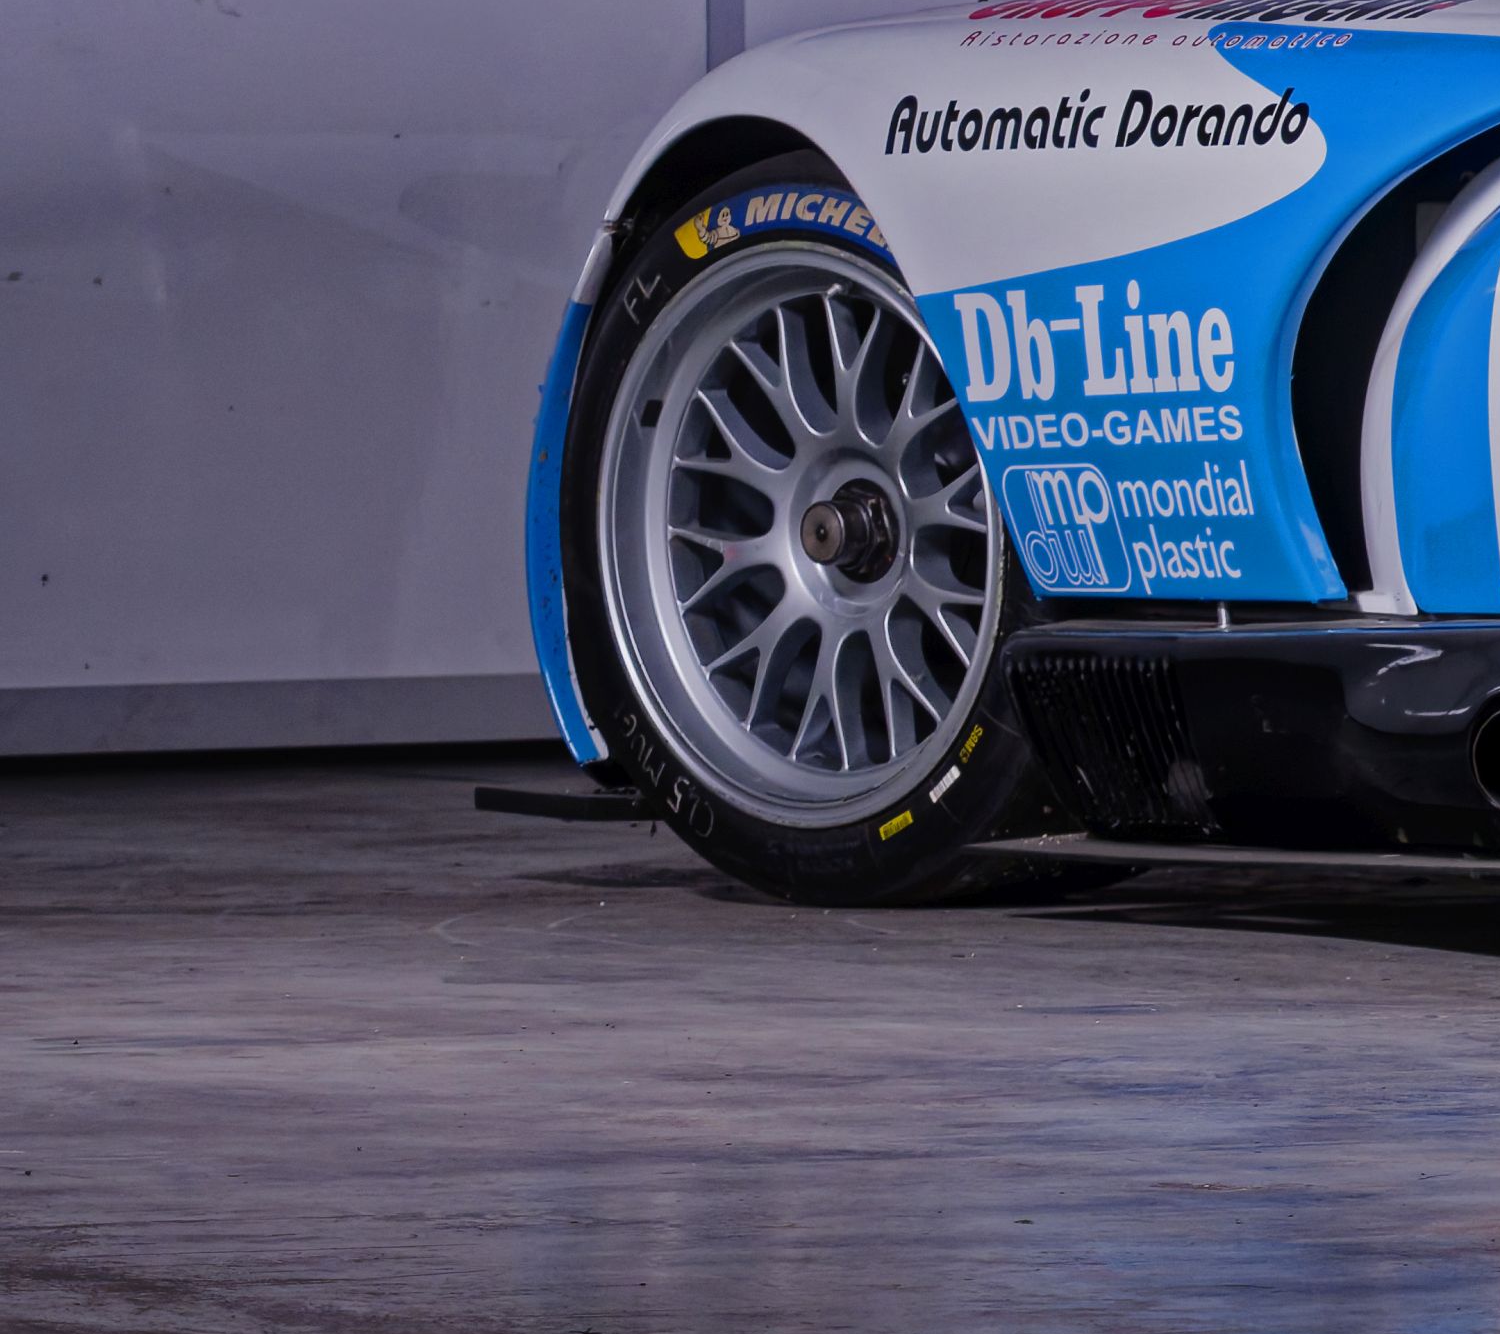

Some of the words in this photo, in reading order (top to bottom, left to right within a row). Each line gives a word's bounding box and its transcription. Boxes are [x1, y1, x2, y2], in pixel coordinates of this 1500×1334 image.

[960, 30, 1158, 48] Ristorazione
[885, 88, 1107, 155] Automatic
[1115, 87, 1310, 149] Dorando
[954, 279, 1235, 403] Db-Line
[972, 405, 1243, 451] VIDEO-GAMES
[1117, 460, 1255, 518] mondial
[1132, 524, 1241, 595] plastic
